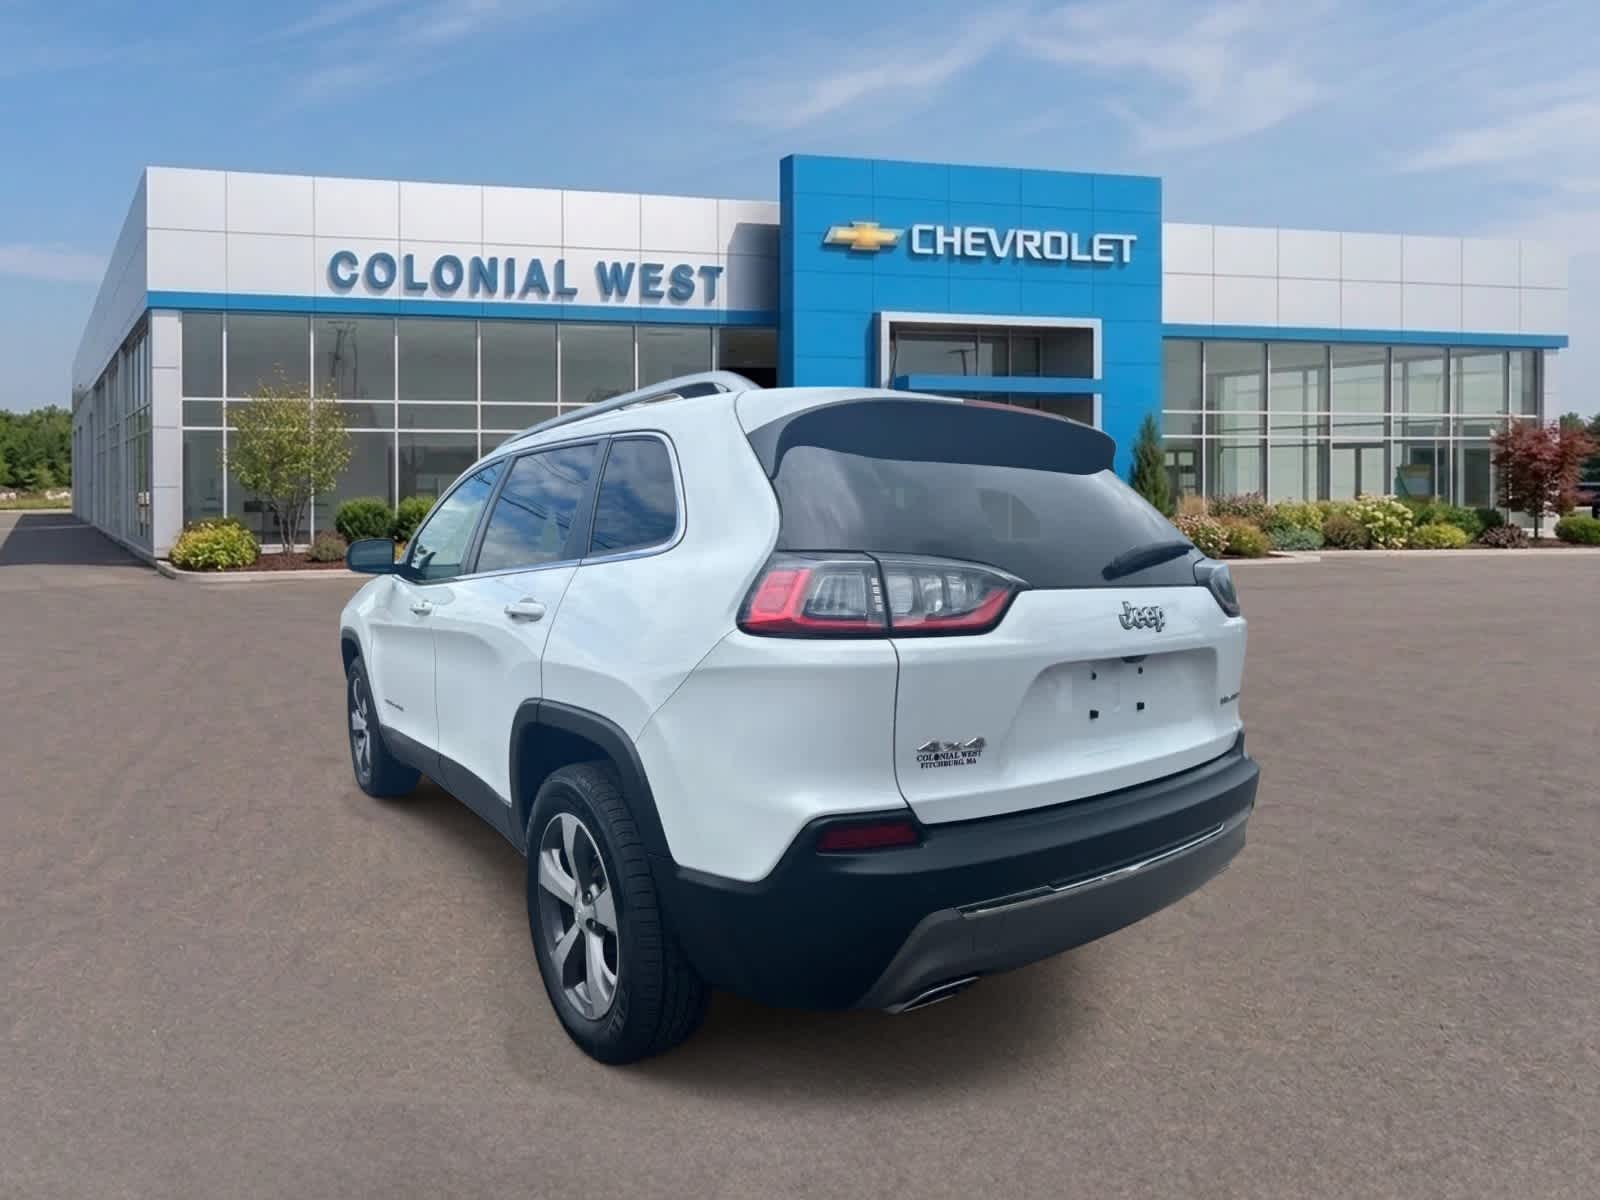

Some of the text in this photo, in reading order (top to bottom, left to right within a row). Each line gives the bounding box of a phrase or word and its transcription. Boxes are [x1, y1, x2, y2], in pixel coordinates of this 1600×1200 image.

[911, 223, 1137, 264] CHEVROLET
[327, 250, 724, 306] COLONIAL WEST
[1118, 600, 1166, 633] Jeep
[916, 750, 983, 762] COLONIAL WEST
[966, 757, 977, 765] MA
